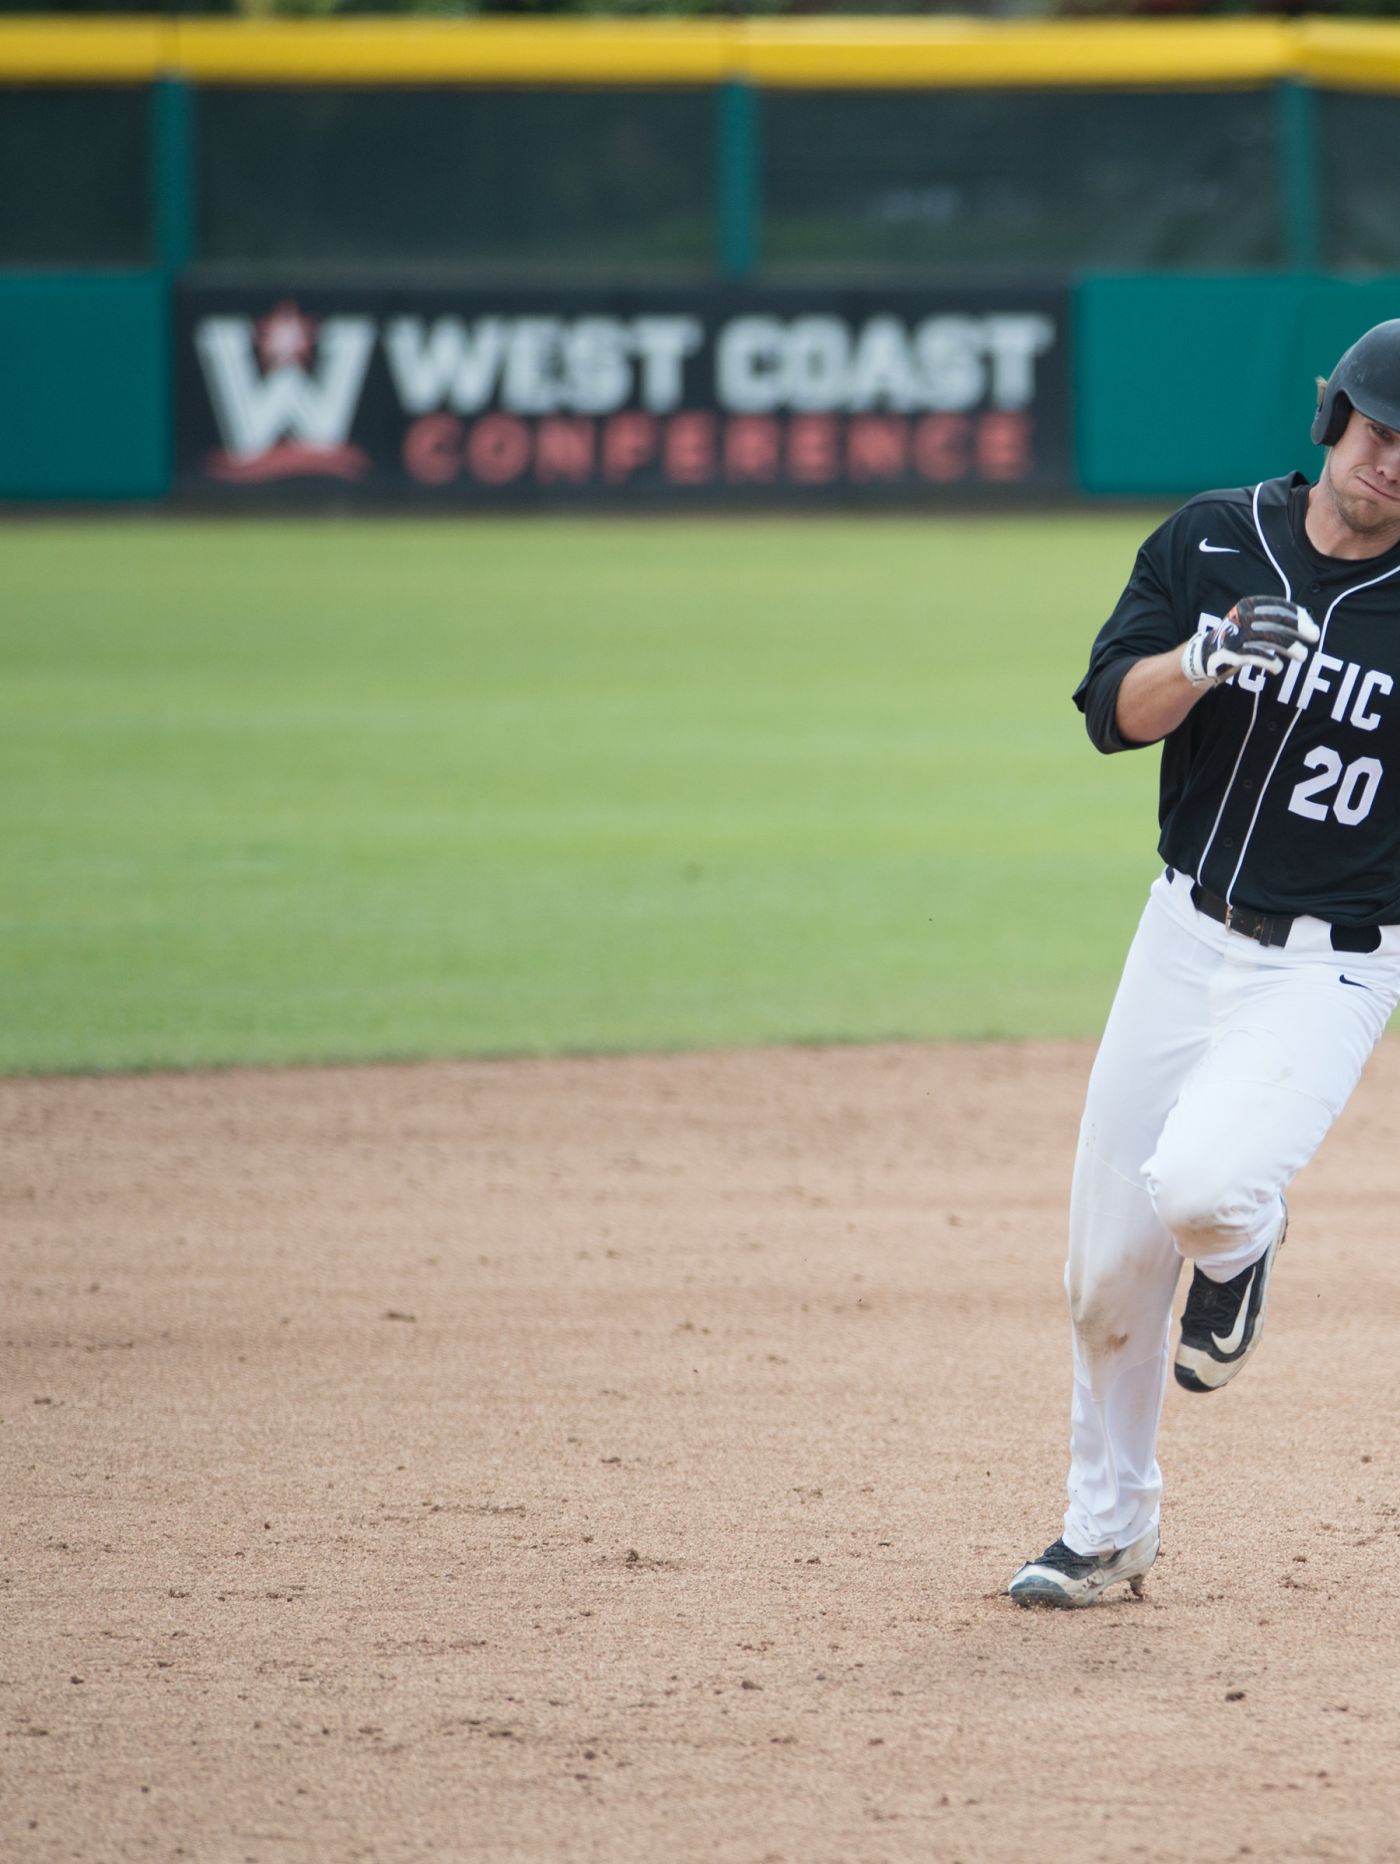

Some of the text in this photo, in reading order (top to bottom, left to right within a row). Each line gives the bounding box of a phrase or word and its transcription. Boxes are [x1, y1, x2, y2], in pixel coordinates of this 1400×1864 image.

[388, 315, 1053, 411] WEST COAST
[405, 413, 1033, 484] CONFERENCE
[1198, 612, 1394, 732] CIFIC
[1288, 745, 1384, 826] 20
